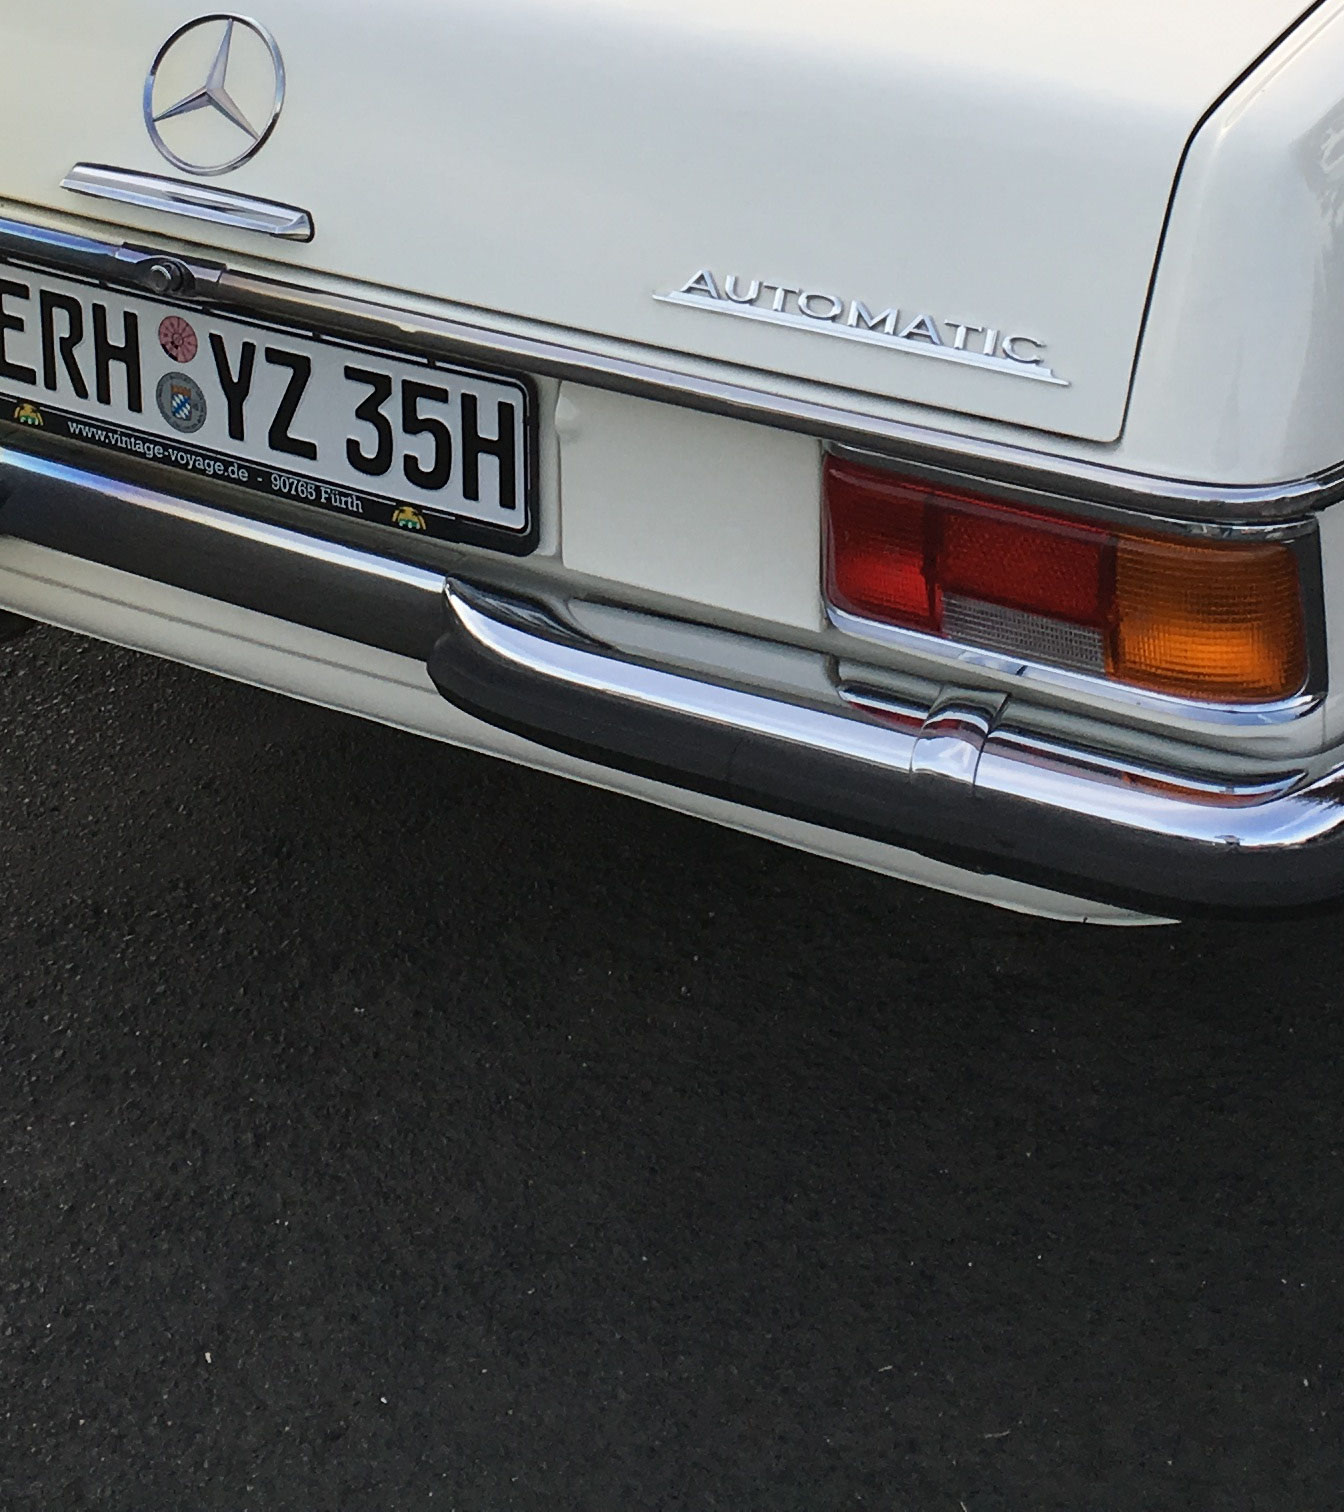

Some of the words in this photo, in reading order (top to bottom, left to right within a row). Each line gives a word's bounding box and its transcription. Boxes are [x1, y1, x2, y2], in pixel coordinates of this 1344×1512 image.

[681, 269, 1047, 364] AUTOMATIC
[67, 420, 248, 482] www.vintage-voyage.de
[270, 473, 316, 500] 90765
[320, 488, 364, 513] Fürth
[209, 332, 317, 460] YZ
[344, 365, 516, 510] 35H
